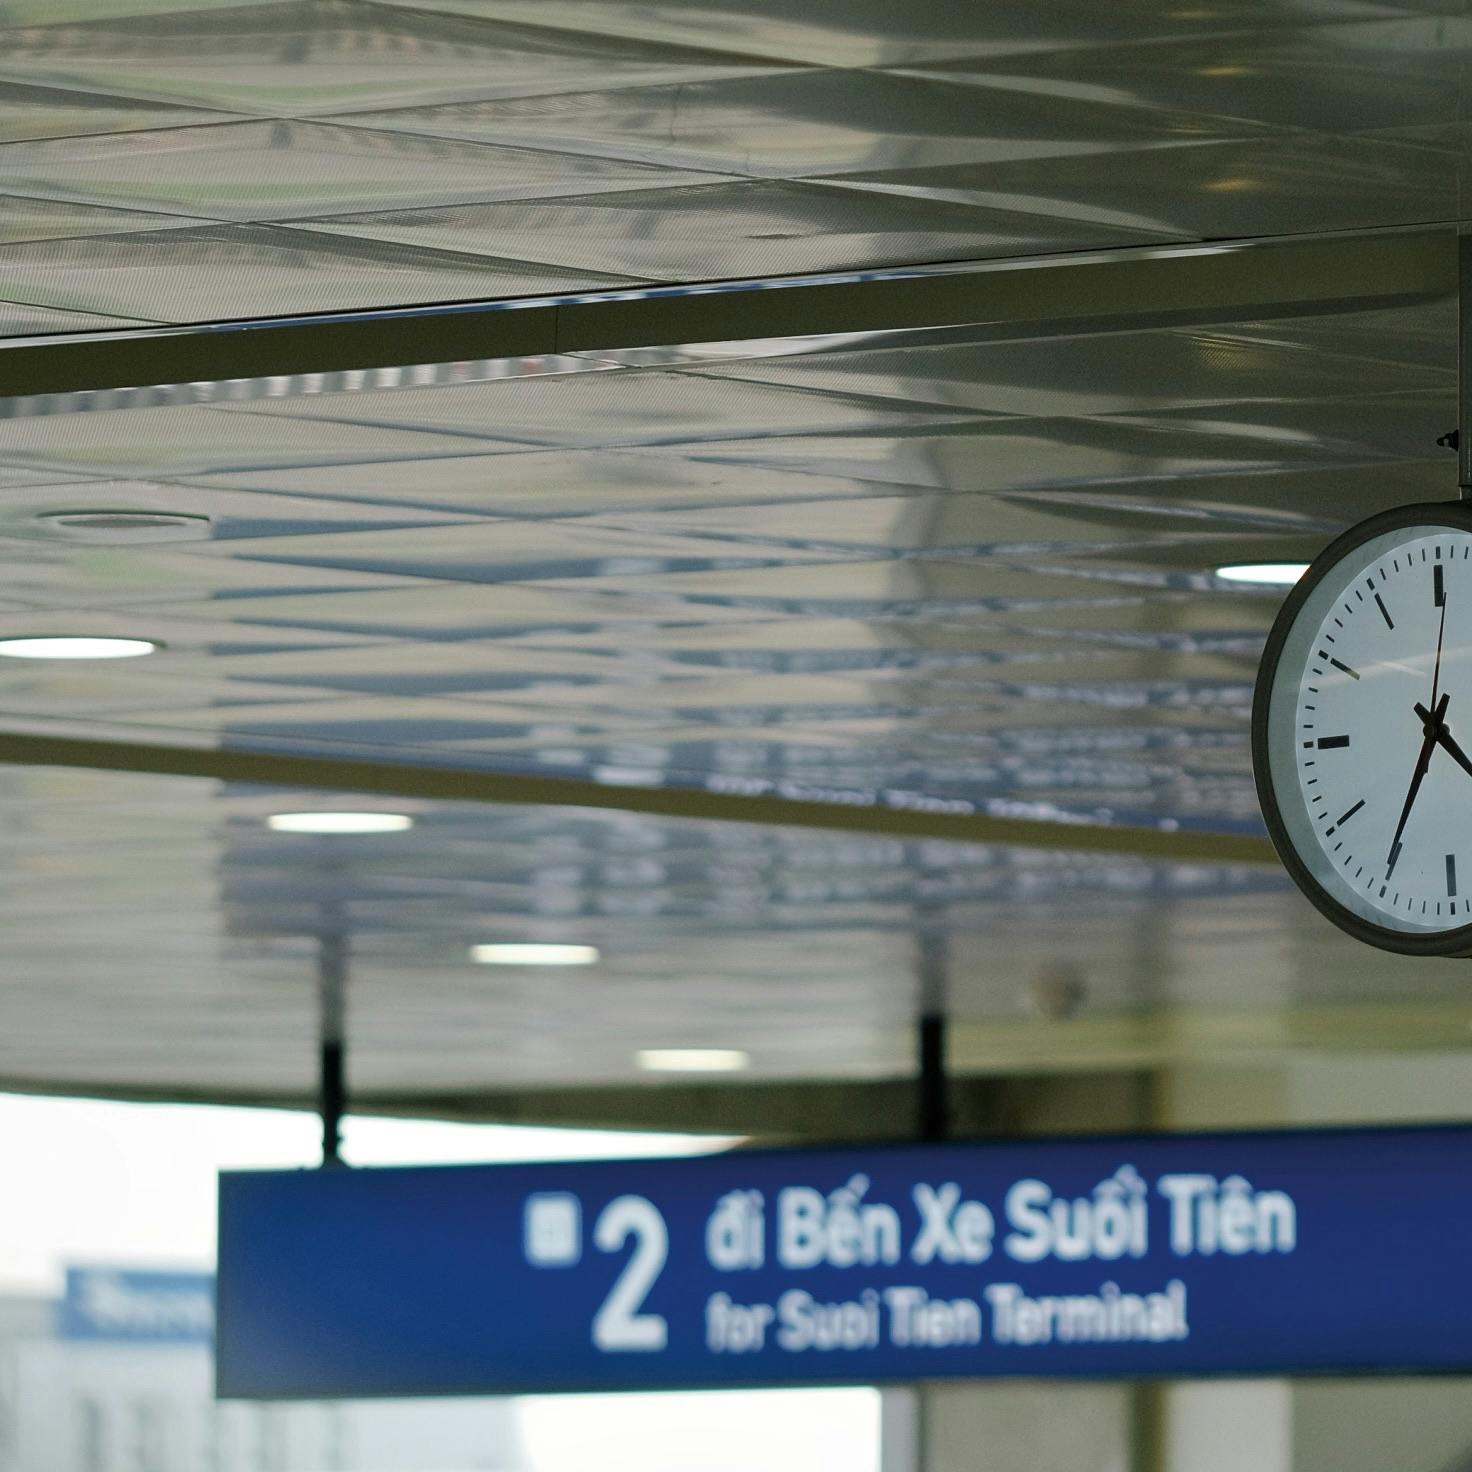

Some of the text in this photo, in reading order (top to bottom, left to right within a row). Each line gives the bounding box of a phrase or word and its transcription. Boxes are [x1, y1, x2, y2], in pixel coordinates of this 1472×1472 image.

[777, 1173, 900, 1269] Bến
[911, 1182, 995, 1265] Xe
[1005, 1164, 1148, 1262] Suối
[1157, 1174, 1296, 1256] Tiên
[593, 1195, 668, 1351] 2
[706, 1279, 1189, 1352] for Suoi Tien Terminal
